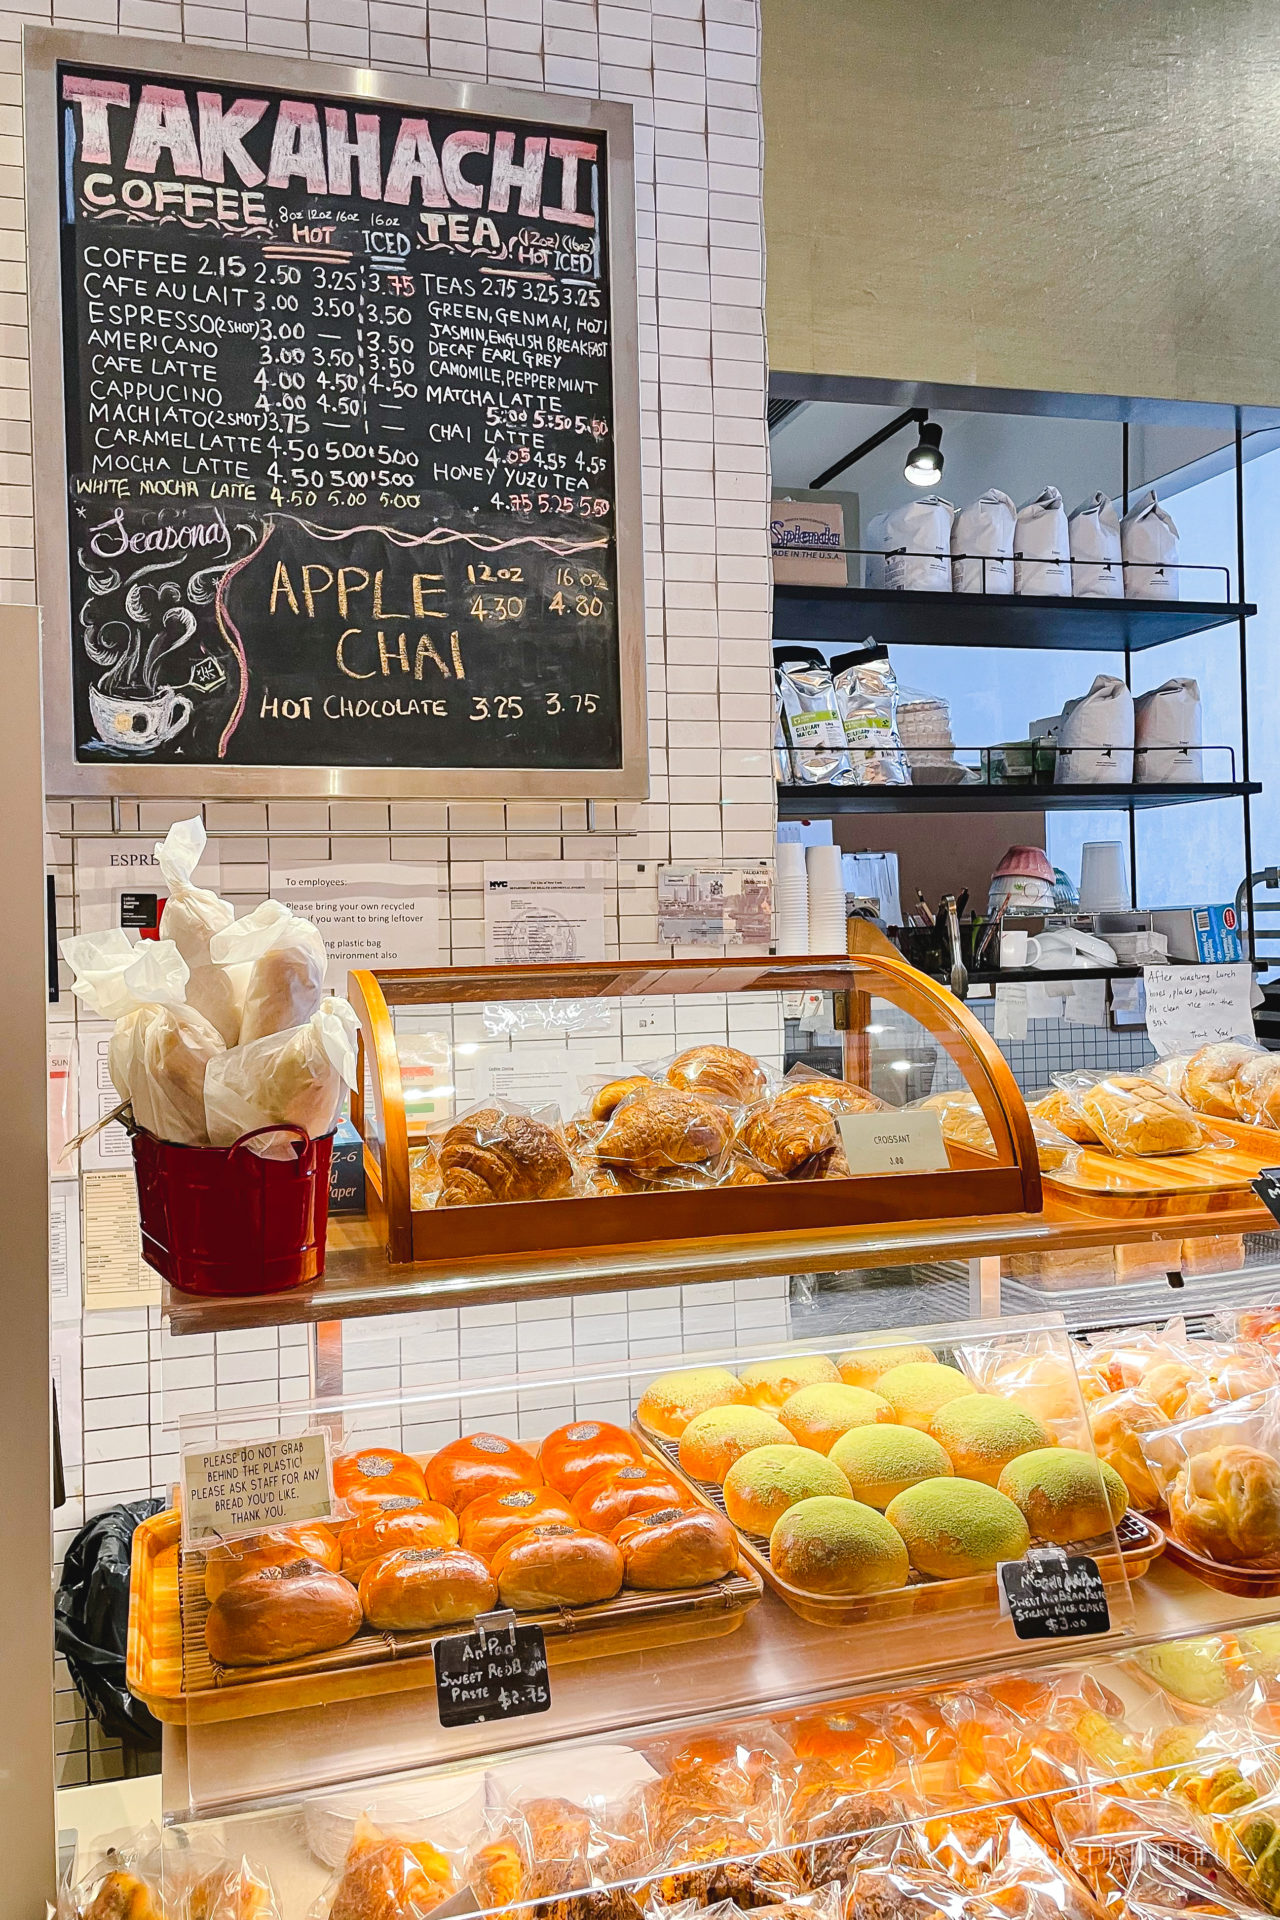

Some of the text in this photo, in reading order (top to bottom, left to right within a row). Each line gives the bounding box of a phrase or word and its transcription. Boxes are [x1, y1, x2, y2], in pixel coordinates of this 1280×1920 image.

[63, 75, 597, 228] TAKAHACHI
[84, 173, 267, 225] COFFEE
[279, 206, 360, 222] 8oz 12oz 16oz
[371, 213, 400, 226] 16oz
[293, 223, 336, 244] HOT
[362, 230, 411, 256] ICED
[420, 213, 500, 247] TEA
[83, 246, 415, 297] COFFEE 2.15 2.50 3.25 3.75
[519, 245, 592, 273] HOT ICED
[84, 272, 412, 325] CAFE AU LAIT 3.00 3.50 3.50
[421, 273, 602, 307] TEAS 2.75 3.25 3.25
[260, 320, 306, 340] 3.00
[367, 331, 414, 355] 3.50
[576, 318, 608, 335] HOJI
[87, 329, 415, 379] AMERICANO 3.00 3.50 3.50
[429, 341, 562, 369] DECAF EARL GREY
[488, 329, 609, 358] ENGLISH BREAKFAST
[92, 354, 418, 398] CAFE LATTE 4.00 4.50 4.50
[506, 368, 599, 395] PEPPERMINT
[90, 380, 360, 416] CAPPUCINO 4.00 4.50
[426, 385, 562, 412] MATCHA LATTE
[89, 403, 207, 428] MACHIATO
[268, 412, 311, 434] 3.75
[574, 415, 609, 437] 5.50
[95, 427, 196, 450] CARAMEL
[199, 432, 262, 454] LATTE
[267, 435, 319, 462] 4.50
[429, 423, 545, 449] CHAI LATTE
[92, 454, 171, 474] MOCHA
[183, 456, 251, 479] LATTE
[267, 461, 324, 488] 4.50
[330, 470, 368, 488] 5.00
[533, 452, 567, 470] 4.55
[574, 450, 607, 475] 4.55
[433, 462, 590, 492] HONEY YUZU TEA
[76, 479, 131, 499] WHITE
[140, 480, 199, 497] MOCHA
[210, 482, 257, 501] LATTE
[270, 487, 318, 508] 4.50
[380, 491, 421, 508] 5.00
[490, 492, 610, 517] 4.75 5.25 5.50
[88, 507, 232, 559] Seasonal
[770, 520, 841, 546] Splenda
[801, 551, 817, 559] THE
[269, 560, 450, 620] APPLE
[469, 591, 603, 621] 4.30 4.80
[336, 628, 466, 681] CHAI
[259, 693, 600, 721] HOT CHOCOLATE 3.25 3.75
[286, 878, 347, 887] To employees:
[315, 902, 338, 912] bring
[339, 903, 359, 913] your
[381, 902, 415, 912] recycled
[315, 916, 332, 924] you
[368, 915, 390, 924] bring
[391, 914, 424, 923] leftover
[337, 939, 382, 949] plastic bag
[380, 951, 398, 960] also
[1148, 970, 1211, 983] After washing
[1163, 1004, 1180, 1013] clean
[873, 1134, 911, 1145] CROISSANT
[889, 1156, 904, 1166] 3.00
[329, 1187, 357, 1201] aper
[203, 1442, 304, 1468] PLEASE DO NOT GRAB
[191, 1468, 320, 1501] PLEASE ASK STAFF FOR ANY
[207, 1469, 239, 1483] BEHIND
[243, 1465, 260, 1477] THE
[215, 1488, 299, 1512] BREAD YOU'D LIKE.
[231, 1504, 286, 1524] THANK YOU.
[1045, 1617, 1087, 1633] $3.00
[440, 1671, 483, 1687] SWEET
[451, 1685, 547, 1710] PASTE $2.75
